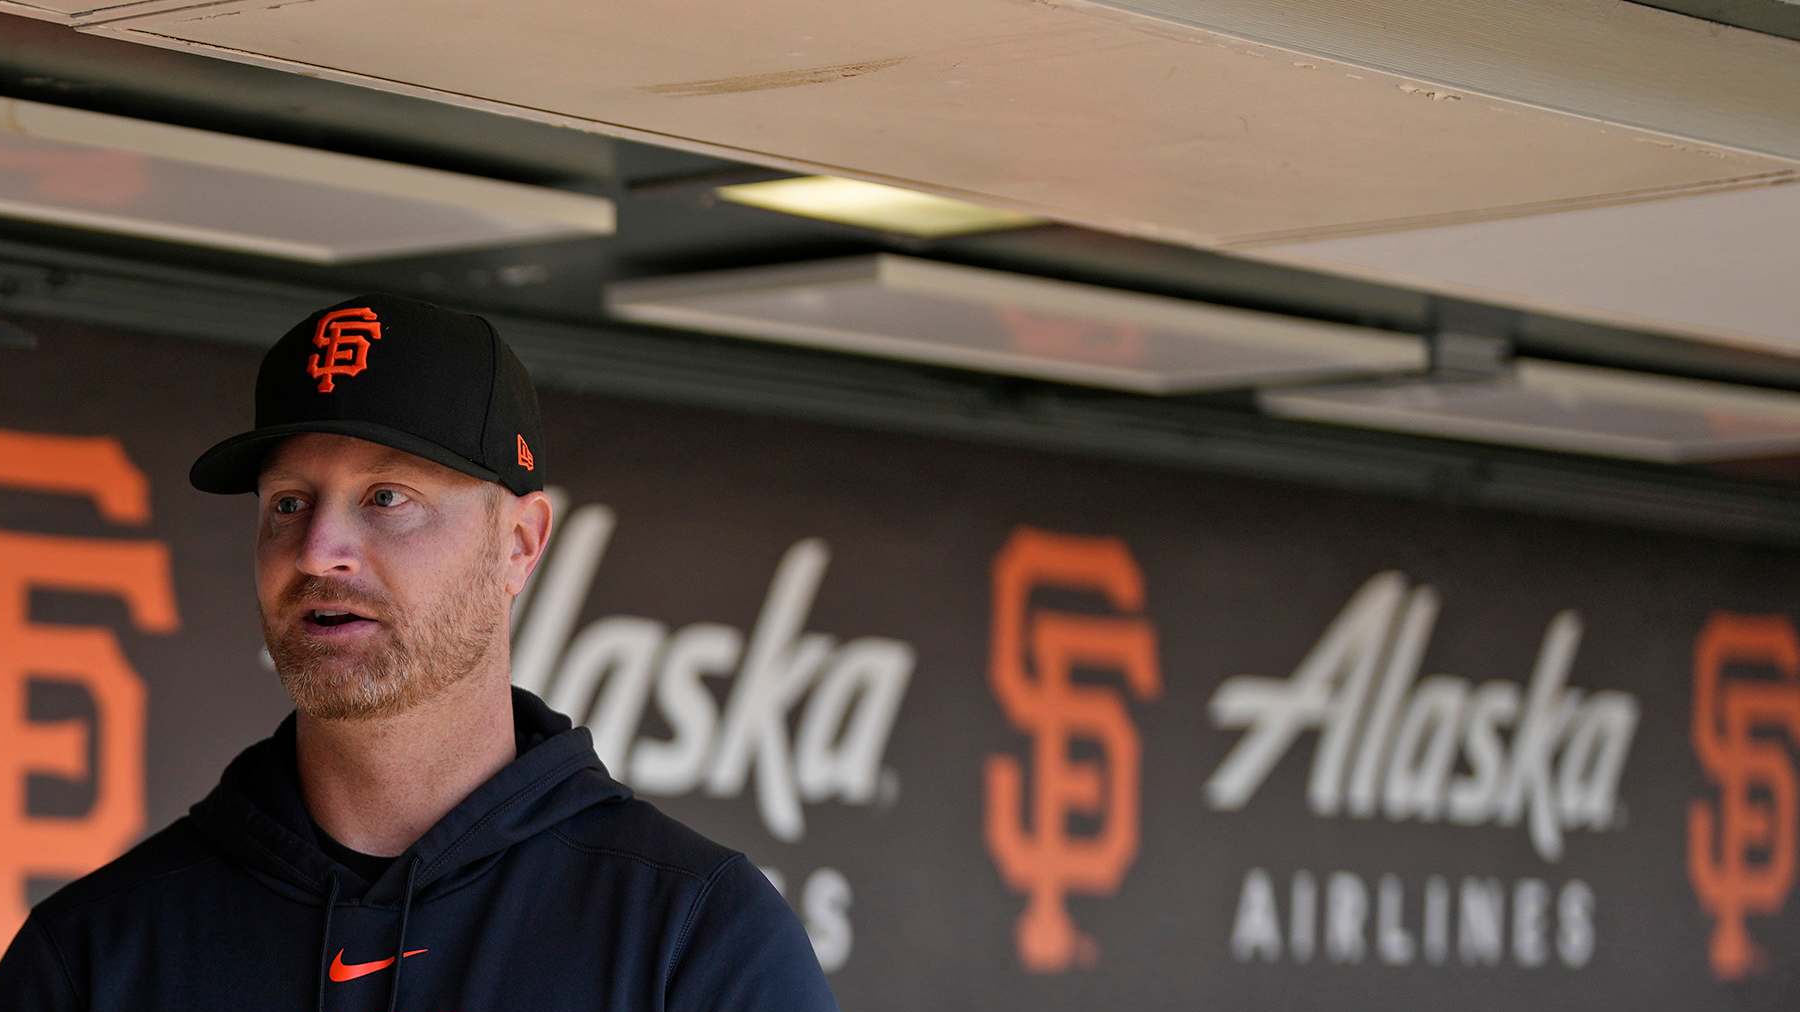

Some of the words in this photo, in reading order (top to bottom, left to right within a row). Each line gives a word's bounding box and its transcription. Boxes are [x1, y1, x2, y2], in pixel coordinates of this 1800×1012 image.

[512, 486, 916, 842] laska
[1204, 568, 1638, 862] Alaska
[1232, 868, 1596, 968] AIRLINES
